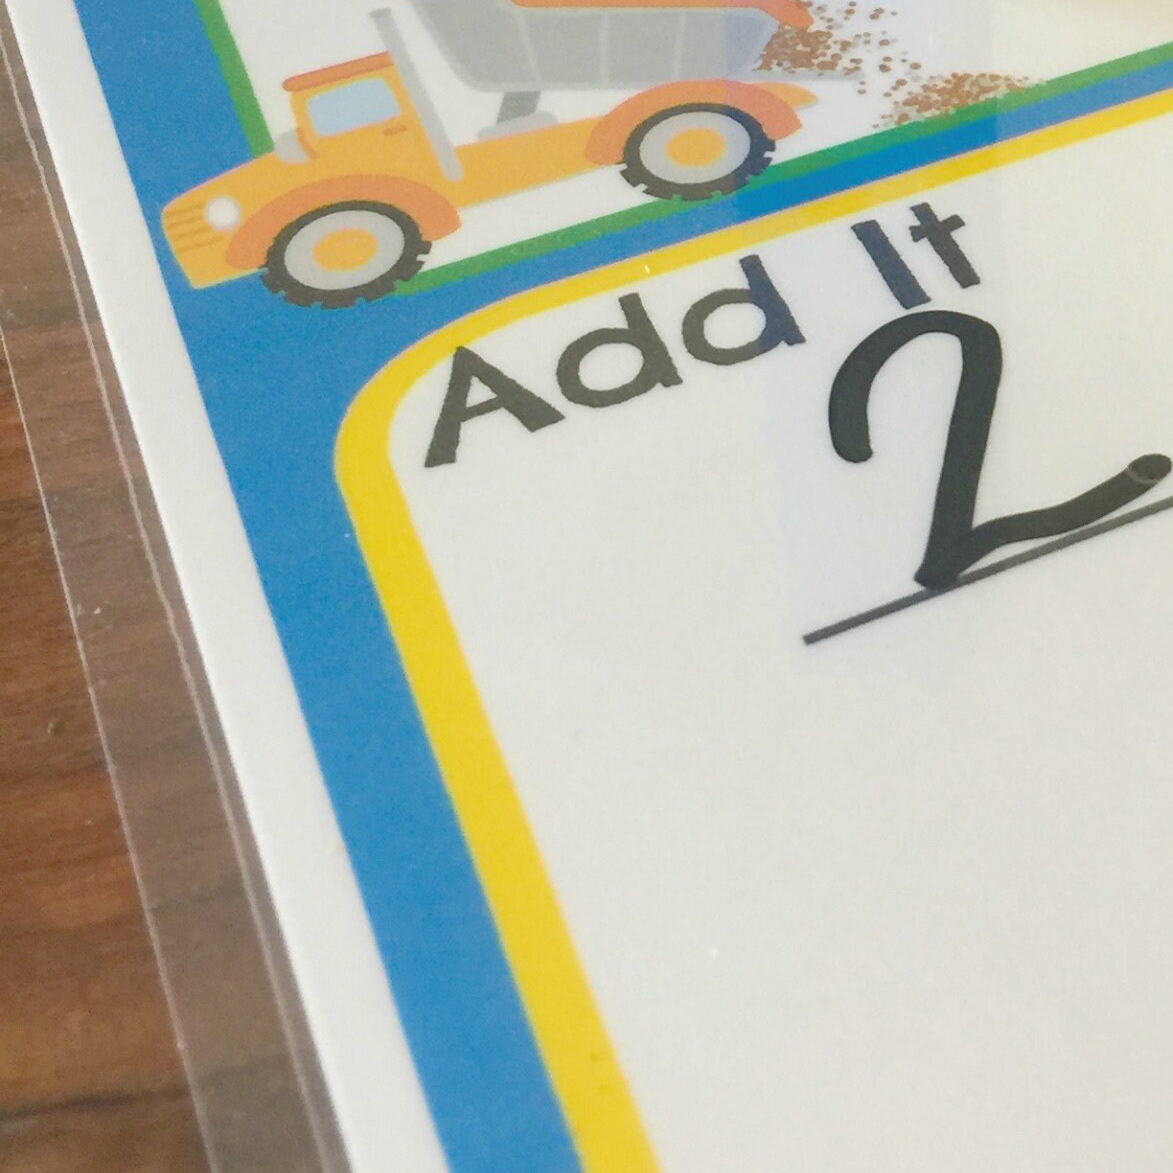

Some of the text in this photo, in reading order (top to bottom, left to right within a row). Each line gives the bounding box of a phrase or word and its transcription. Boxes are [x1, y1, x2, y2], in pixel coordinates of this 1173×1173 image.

[424, 202, 981, 468] Add It
[828, 309, 1173, 590] 2
